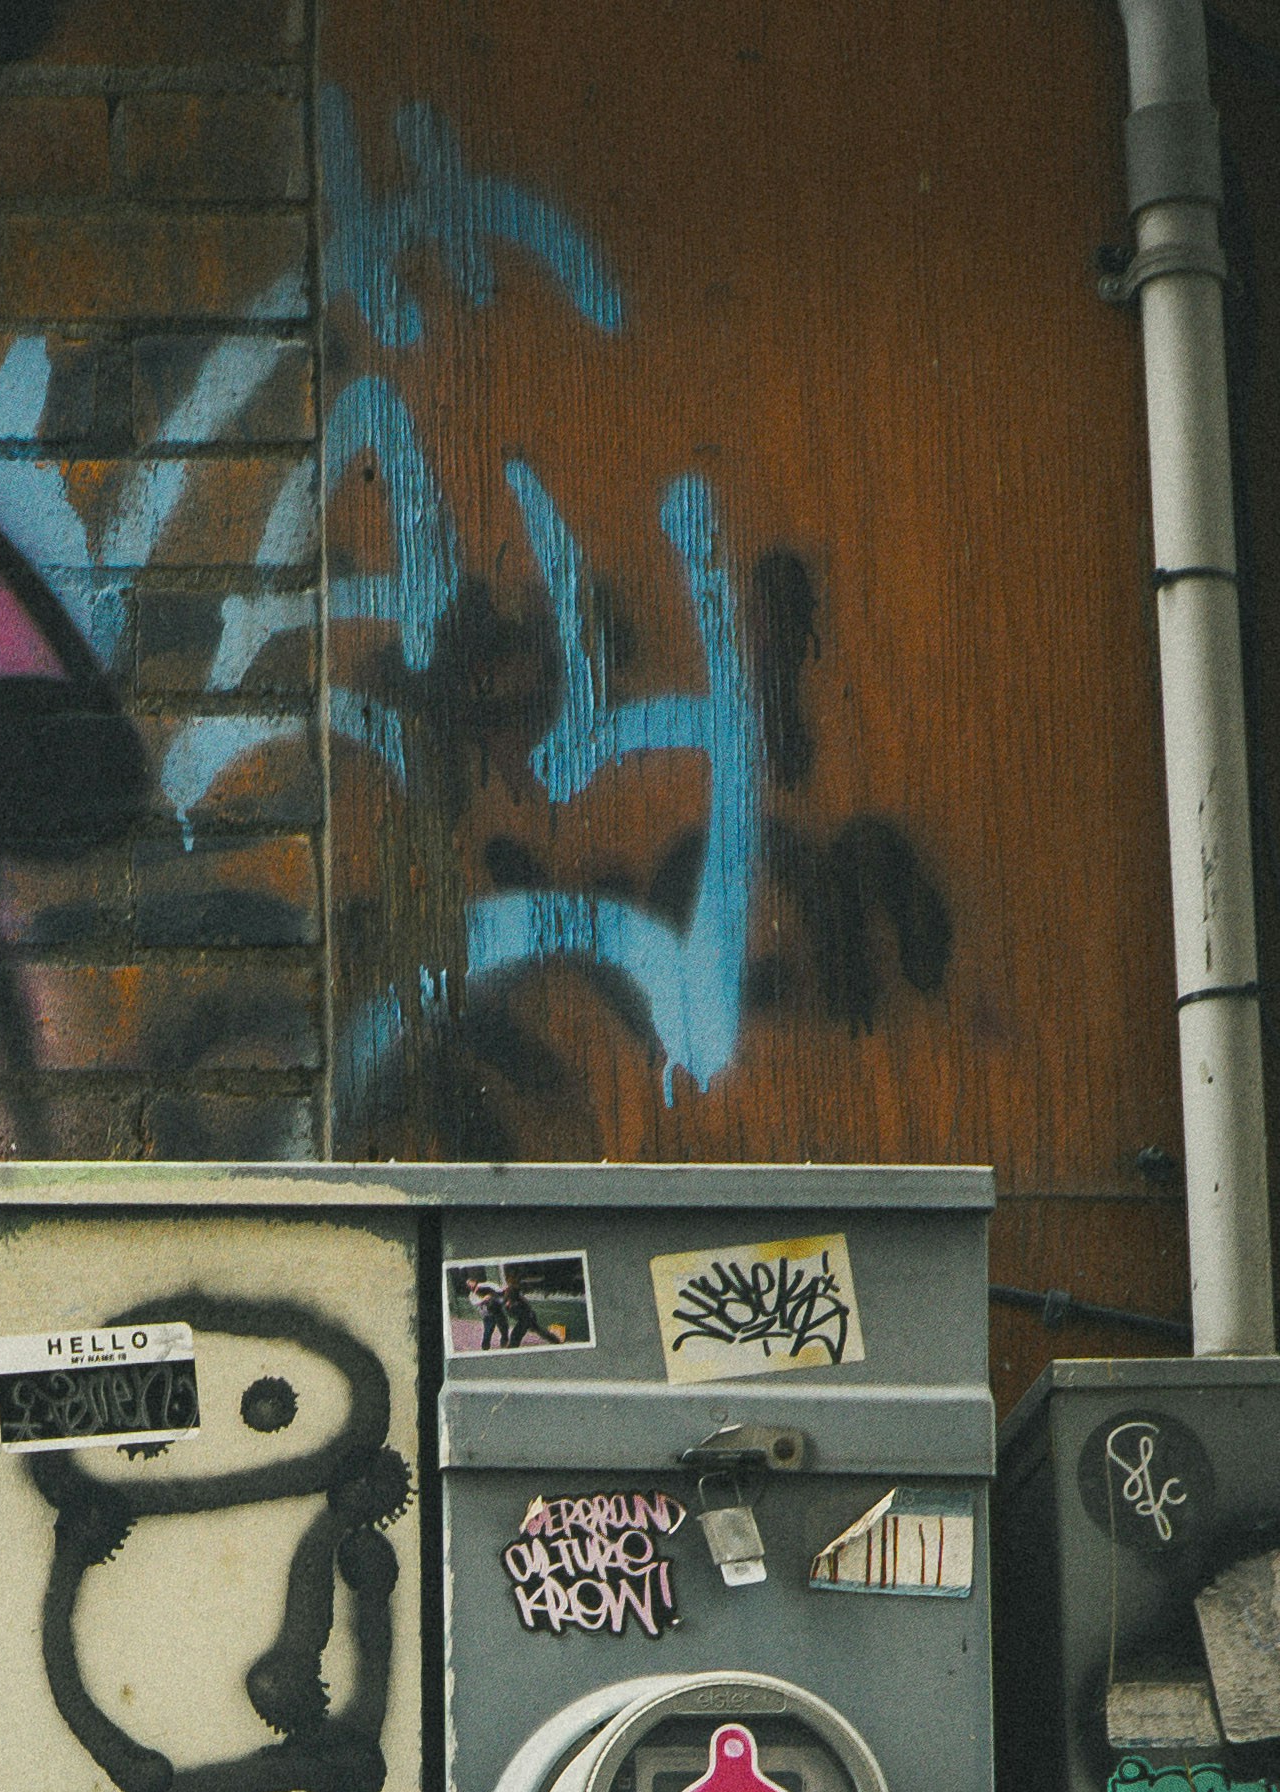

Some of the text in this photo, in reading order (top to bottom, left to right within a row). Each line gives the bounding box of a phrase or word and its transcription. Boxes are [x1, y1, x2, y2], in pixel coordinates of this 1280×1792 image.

[47, 1331, 148, 1355] HELLO
[71, 1355, 85, 1364] MY
[88, 1353, 115, 1363] NAME
